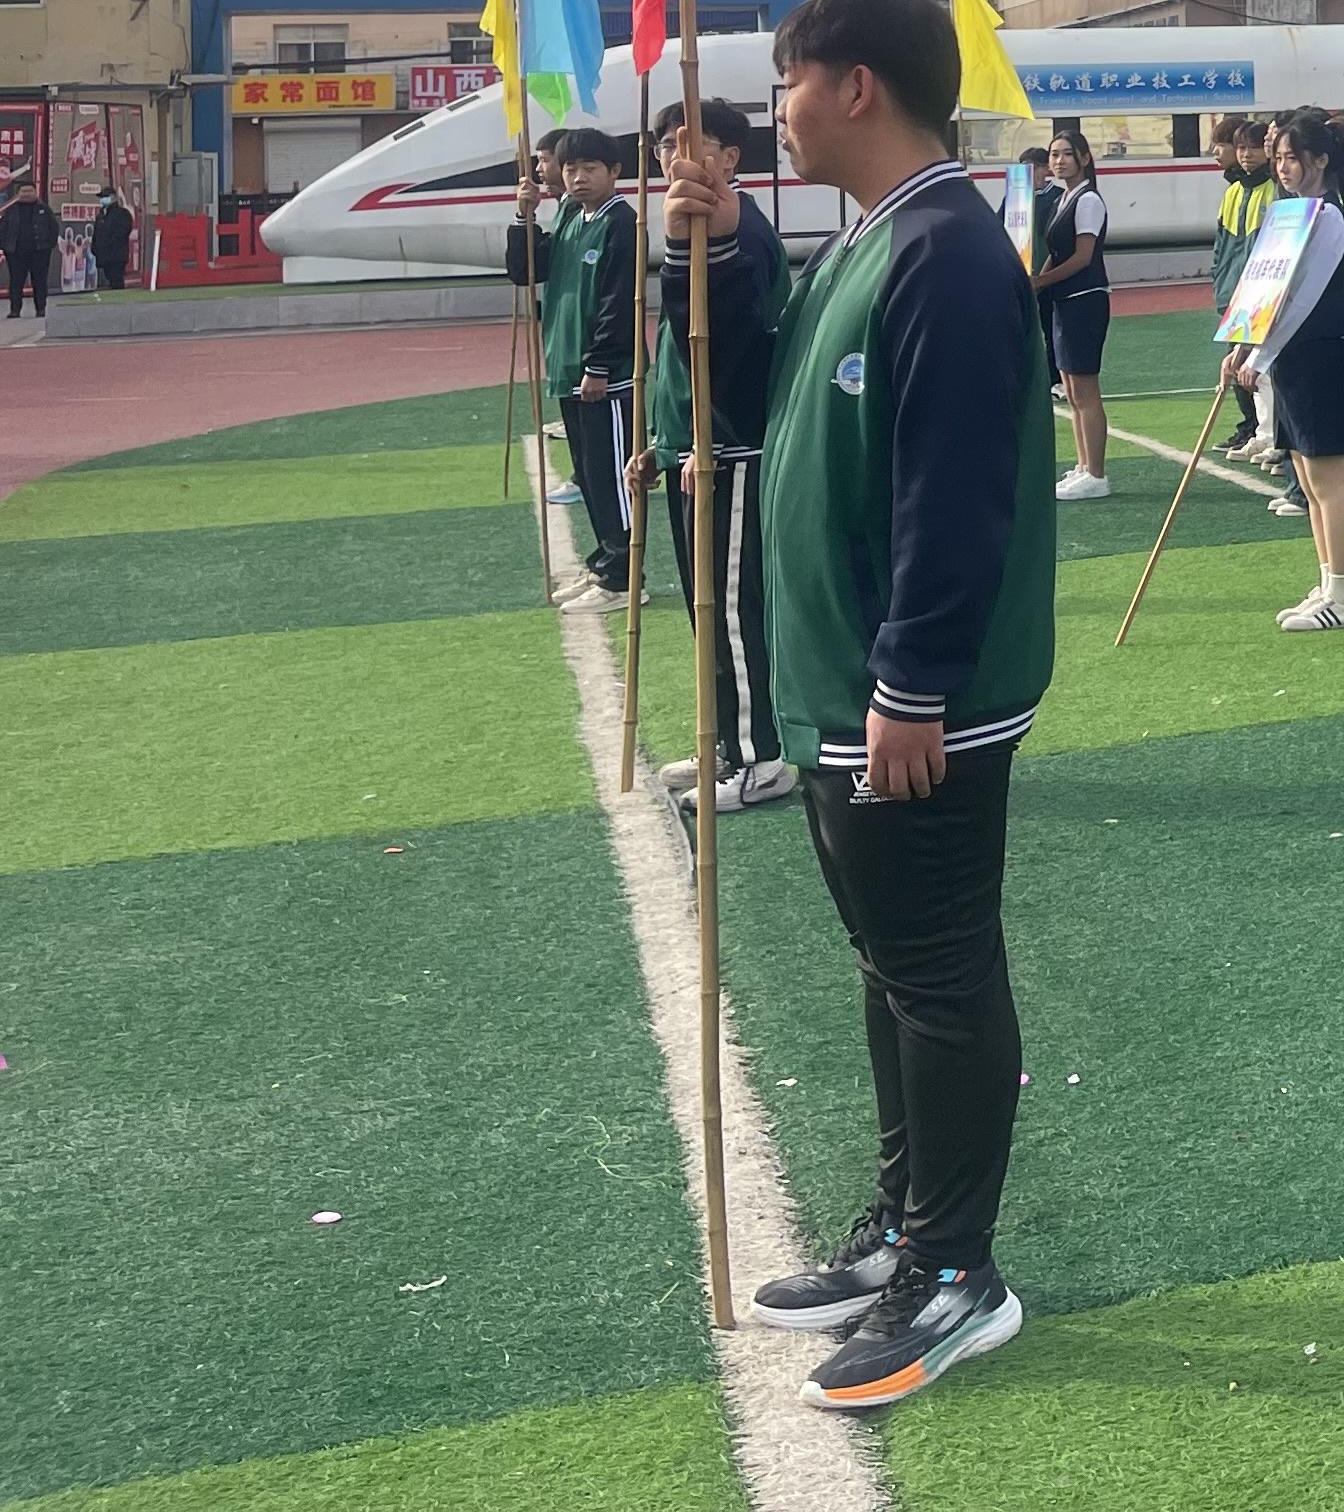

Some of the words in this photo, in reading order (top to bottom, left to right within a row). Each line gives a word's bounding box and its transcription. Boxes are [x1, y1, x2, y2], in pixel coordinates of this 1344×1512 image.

[243, 78, 376, 104] 家常面馆
[415, 69, 503, 97] 山西
[1023, 68, 1245, 92] 铁轨道职业技工学校
